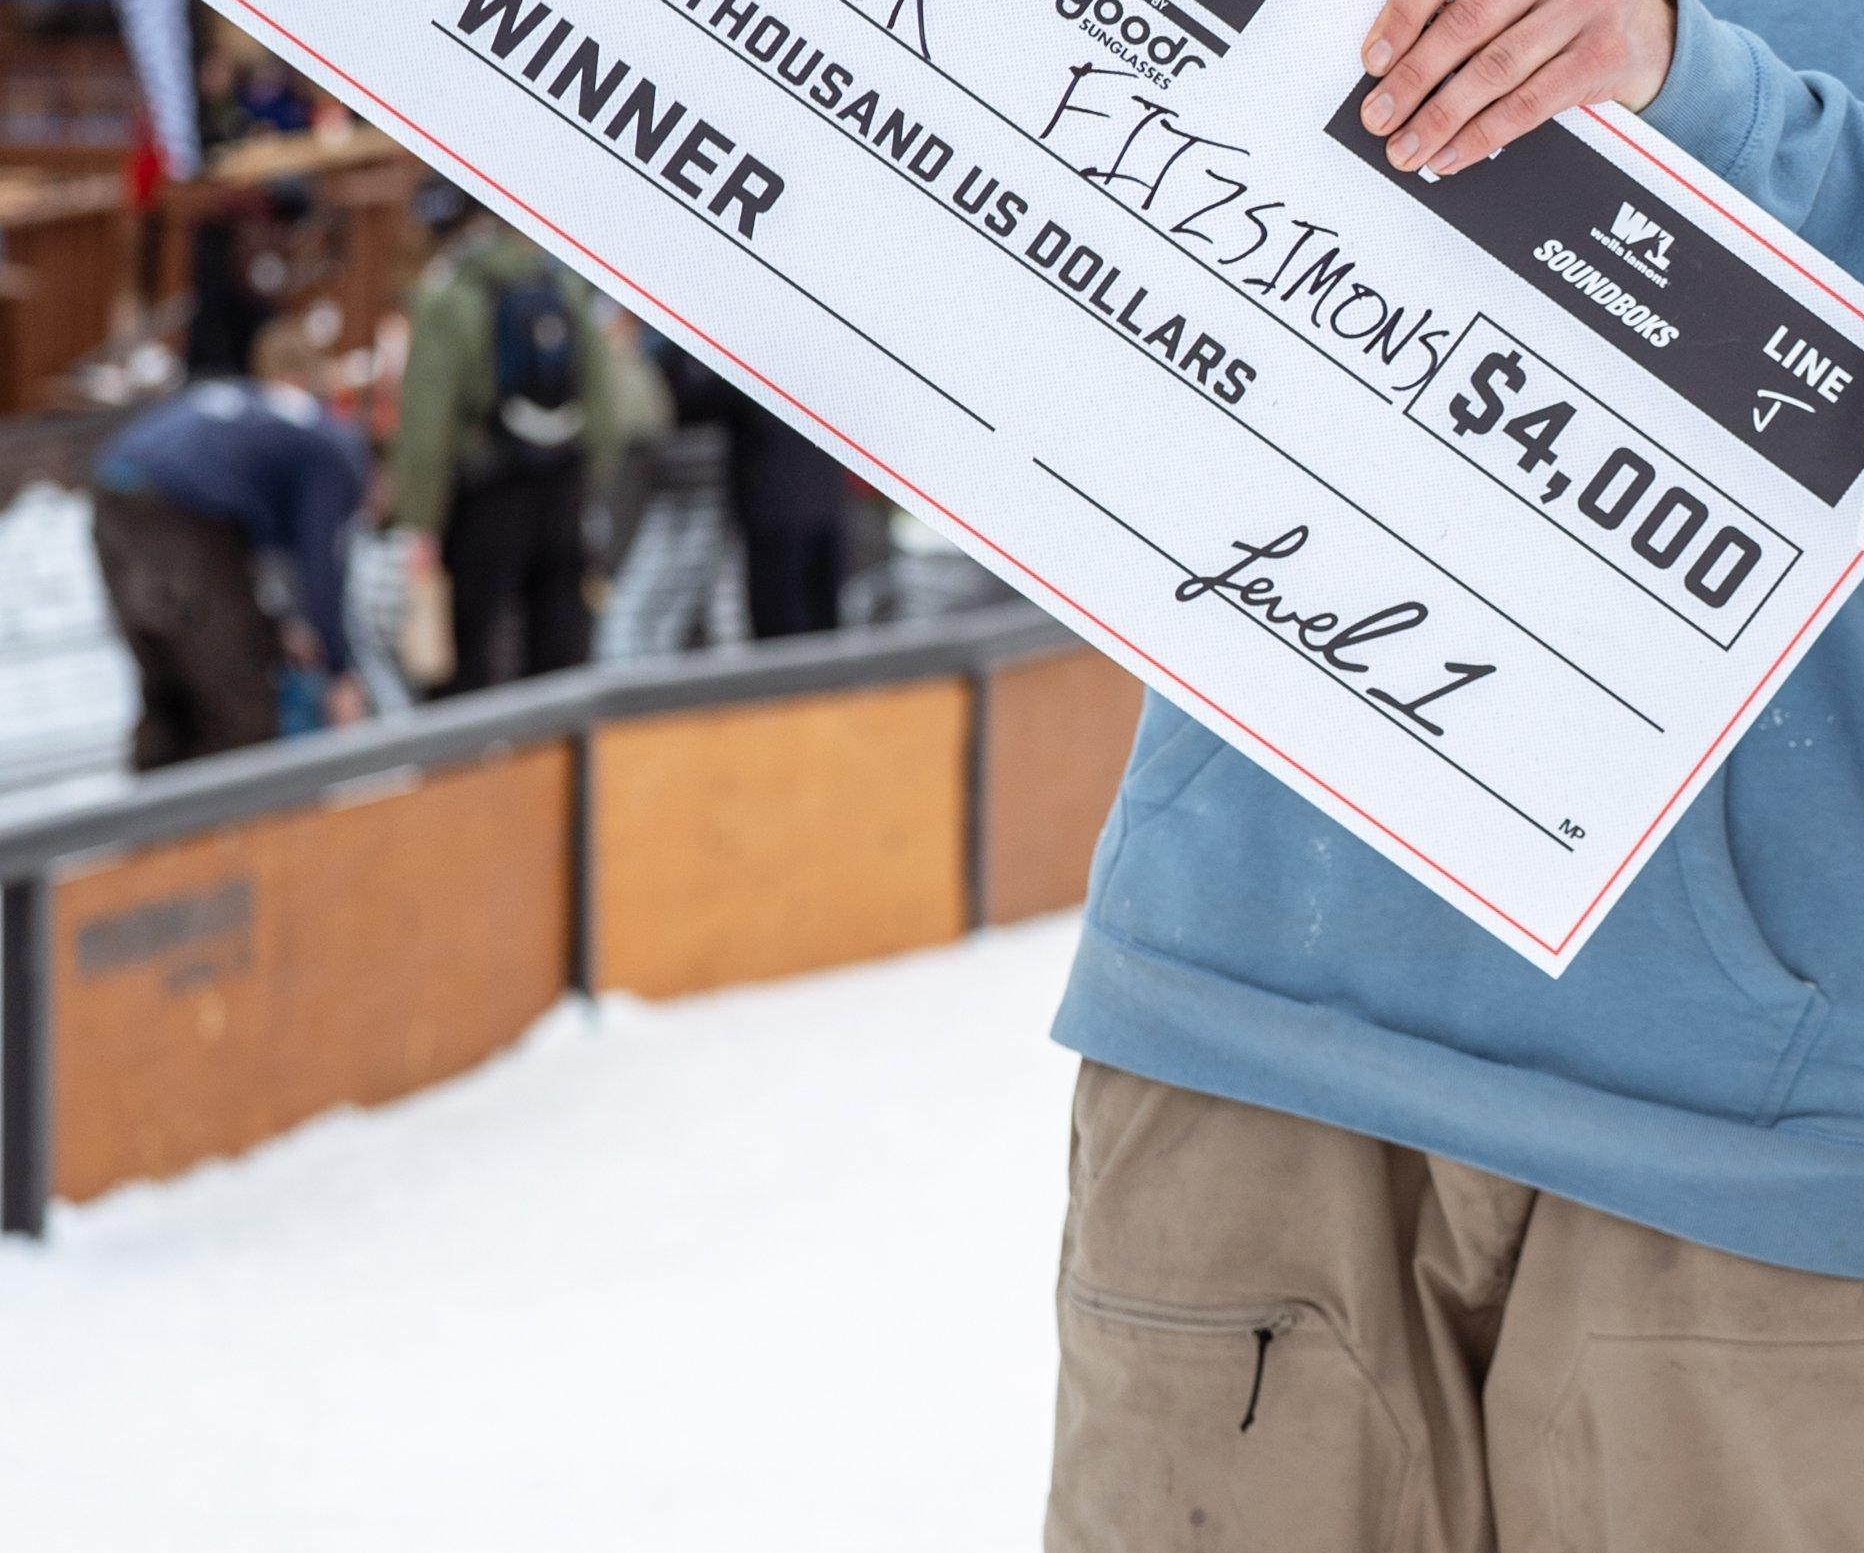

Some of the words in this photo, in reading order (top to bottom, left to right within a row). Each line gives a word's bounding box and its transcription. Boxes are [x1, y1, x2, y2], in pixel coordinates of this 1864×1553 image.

[1079, 18, 1171, 90] SUNGLASSES
[952, 165, 1028, 237] US
[1024, 220, 1256, 404] DOLLARS
[1533, 239, 1679, 347] SOUNDBOKS
[1590, 227, 1624, 256] wells
[1623, 250, 1667, 288] lamont
[1762, 325, 1852, 403] LINE
[1449, 350, 1761, 608] $4,000
[1367, 660, 1497, 736] 1
